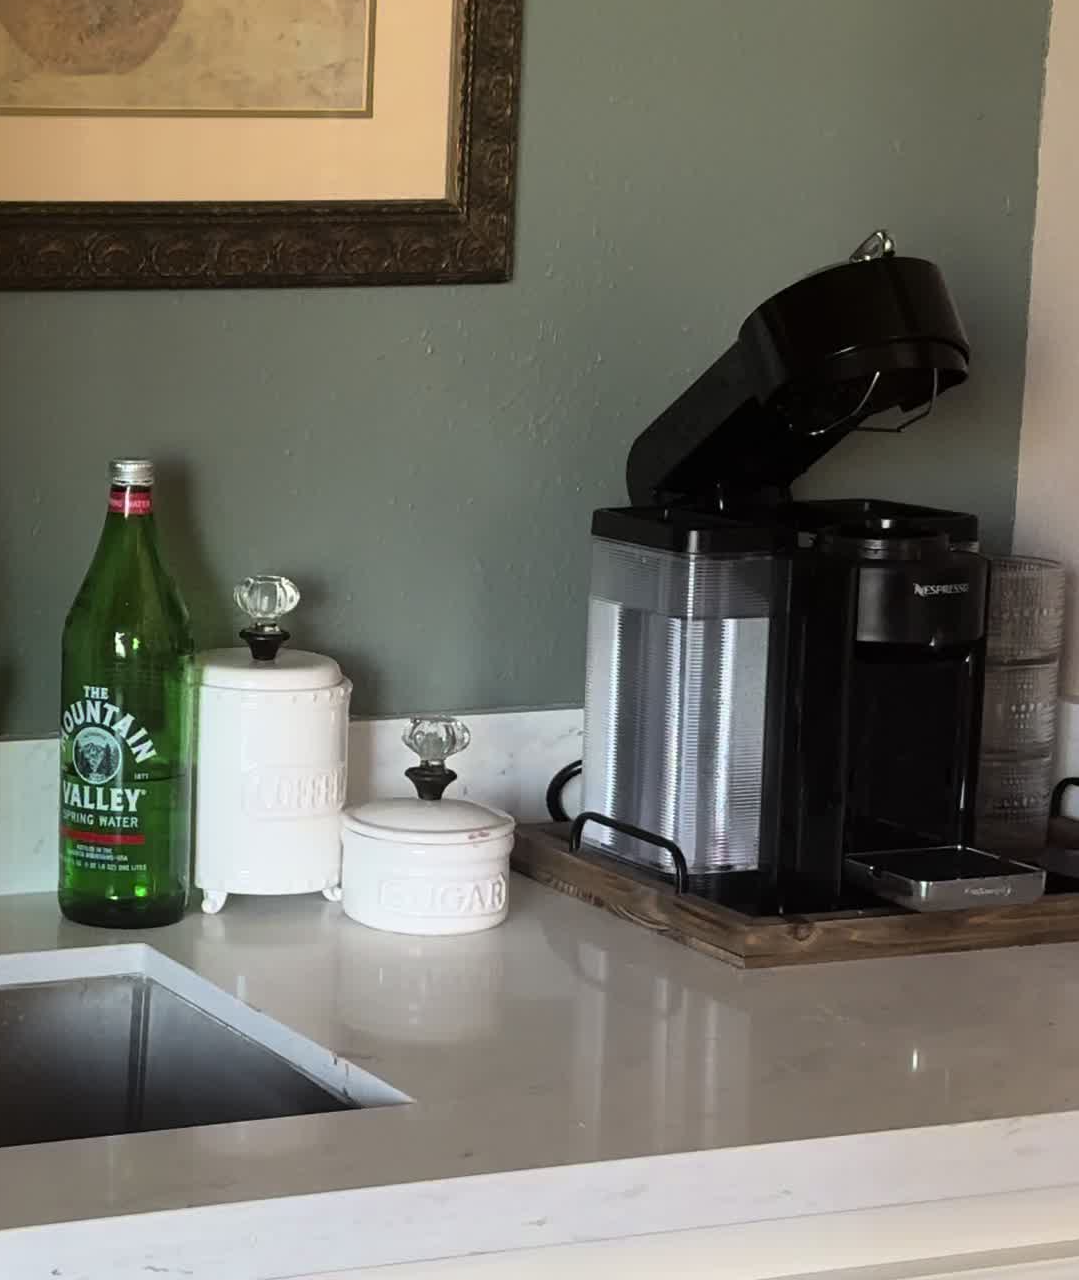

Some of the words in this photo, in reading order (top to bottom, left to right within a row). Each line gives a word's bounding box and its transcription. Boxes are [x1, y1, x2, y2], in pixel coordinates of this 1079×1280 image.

[913, 582, 969, 597] NESPRESSO
[83, 685, 110, 700] THE
[99, 815, 139, 828] WATER
